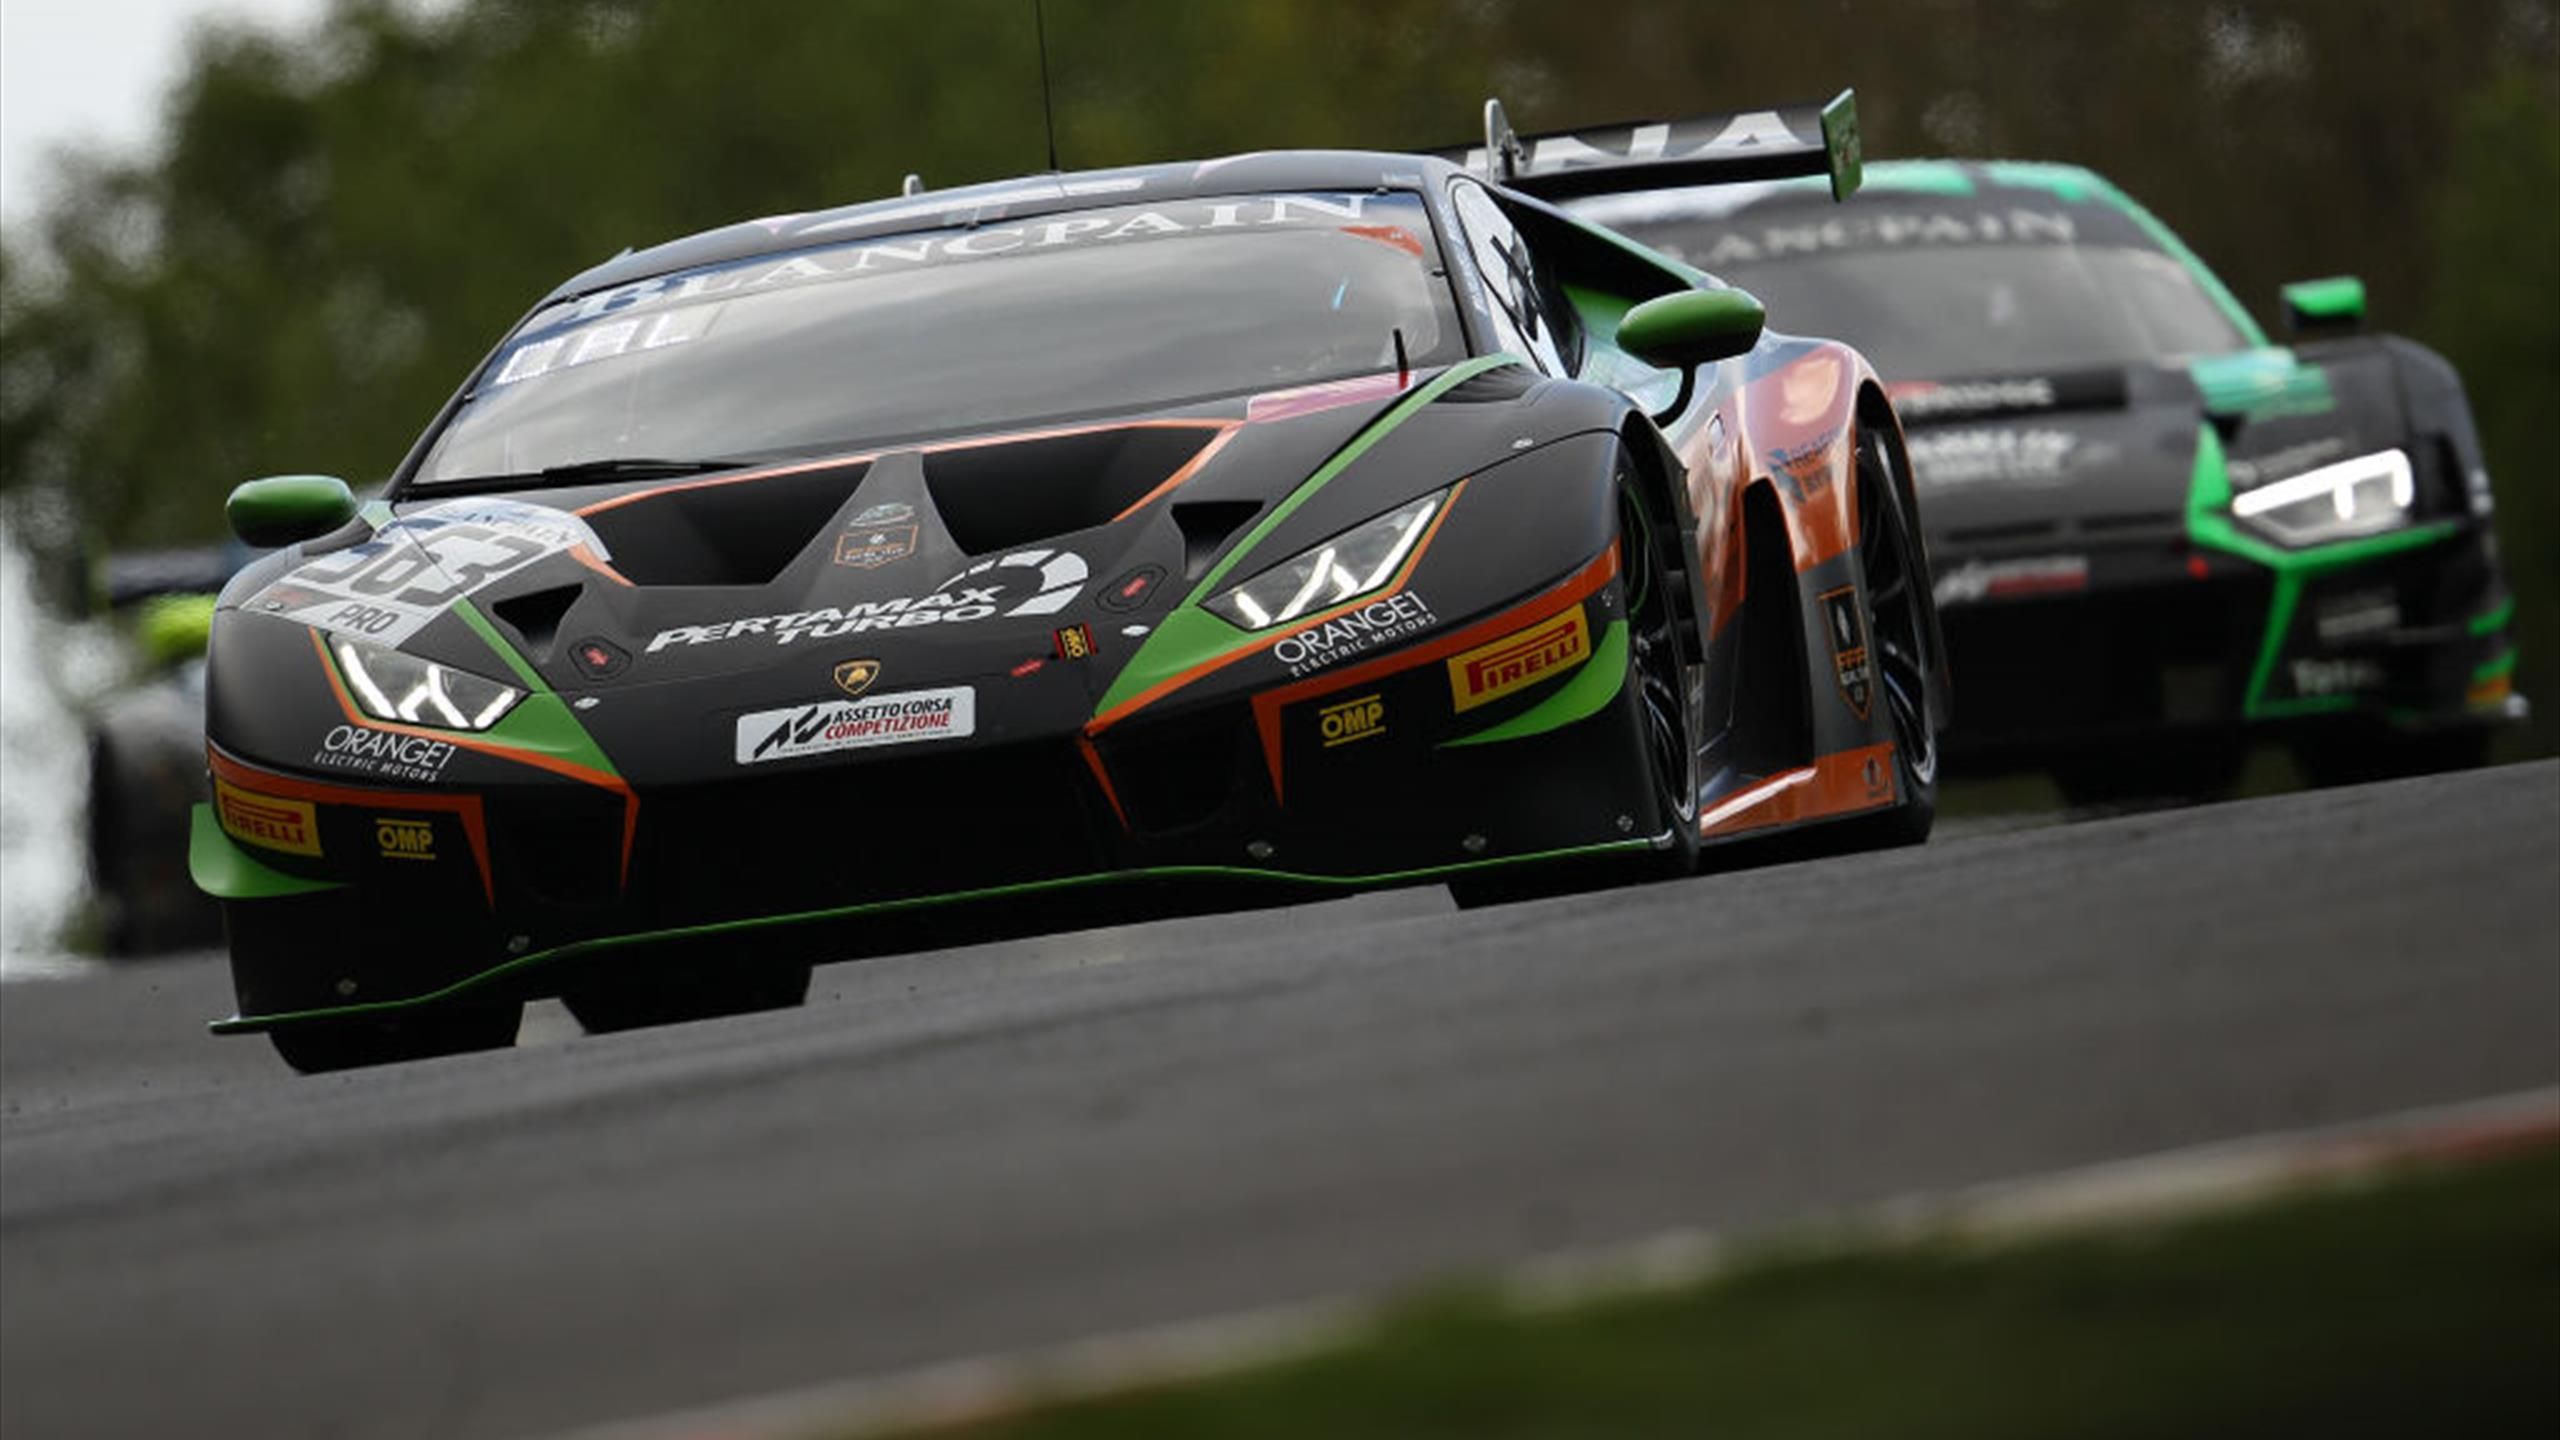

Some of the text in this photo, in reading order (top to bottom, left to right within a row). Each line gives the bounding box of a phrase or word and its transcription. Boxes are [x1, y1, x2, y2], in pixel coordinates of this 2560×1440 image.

[564, 194, 1376, 324] BLANCPAIN
[327, 603, 399, 634] PRO
[645, 585, 1006, 653] PERTAMAX
[777, 605, 997, 645] TURBO
[1274, 590, 1429, 663] ORANGE1
[1289, 611, 1438, 678] ELECTRIC MOTORS
[1464, 620, 1580, 696] PIRELLI
[824, 711, 951, 741] COMPETIZIONE
[832, 697, 954, 725] ASSETTO CORSA
[1321, 702, 1384, 738] OMP
[313, 751, 438, 783] ELECTRIC MOTORS
[324, 725, 456, 770] ORANGE1
[377, 826, 434, 853] OMP
